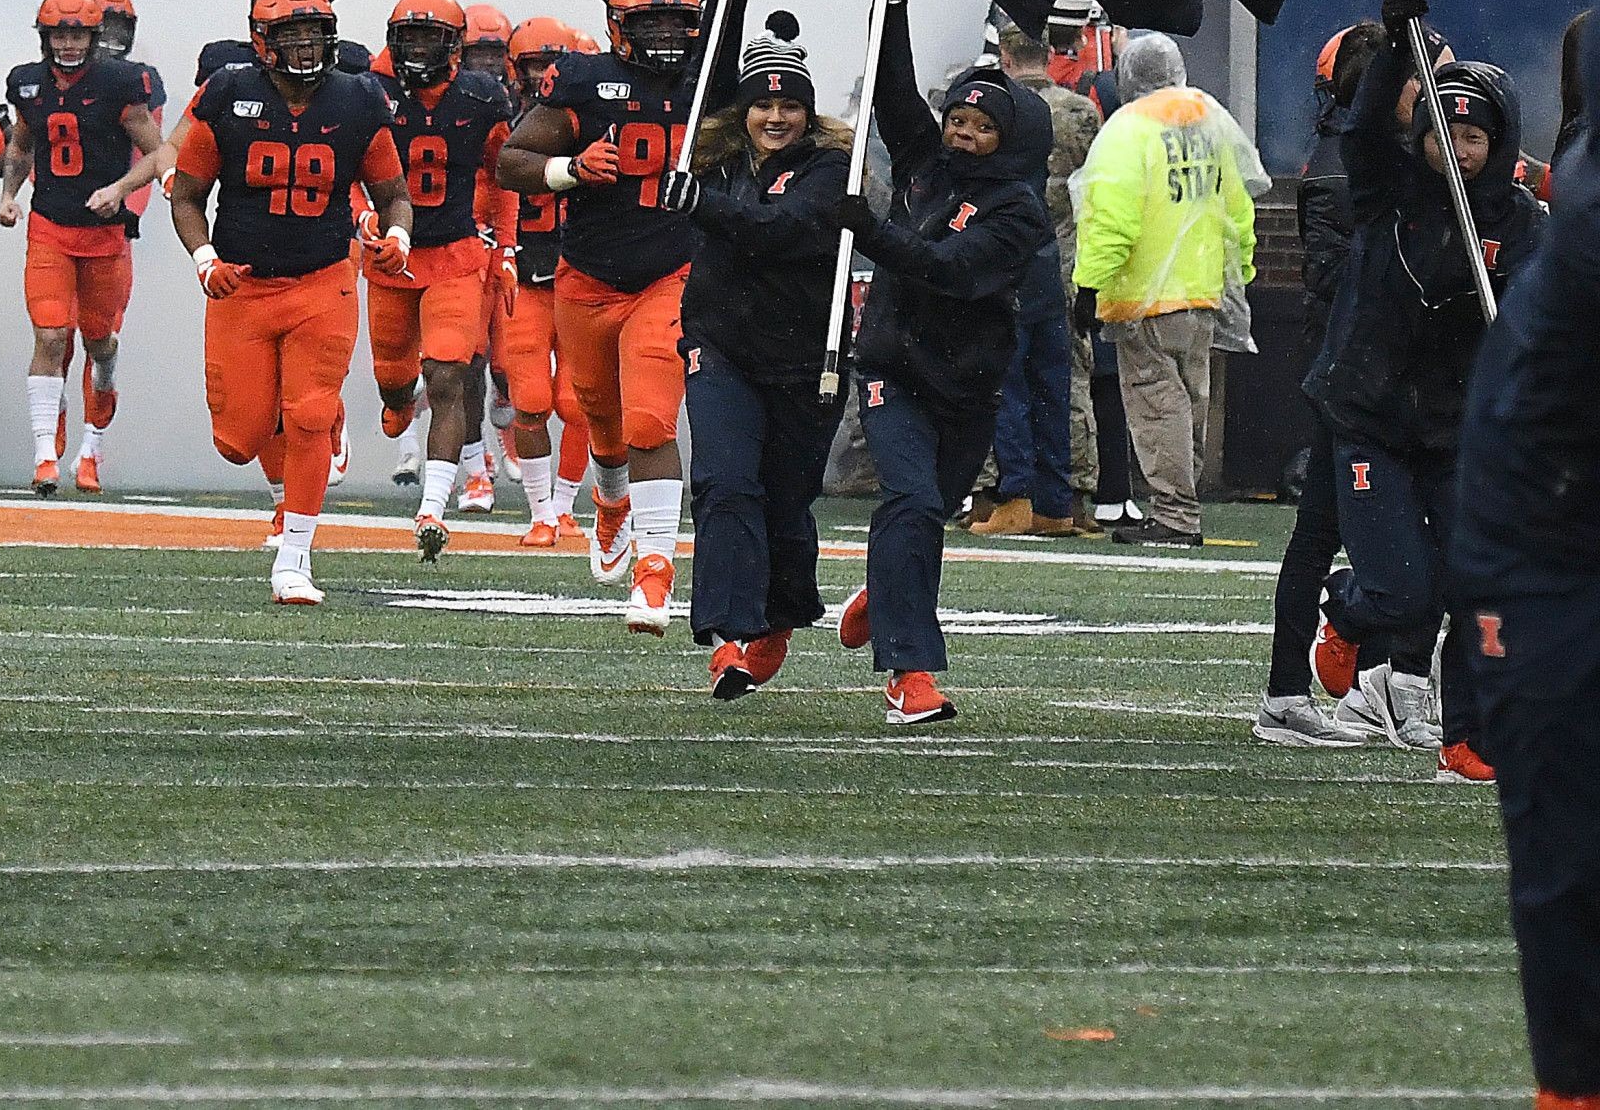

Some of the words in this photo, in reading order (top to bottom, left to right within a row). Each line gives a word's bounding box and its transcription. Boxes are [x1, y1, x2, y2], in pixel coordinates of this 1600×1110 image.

[47, 111, 84, 177] 8
[407, 135, 448, 207] 8
[949, 201, 978, 232] I
[867, 380, 885, 408] I
[1352, 462, 1371, 491] I
